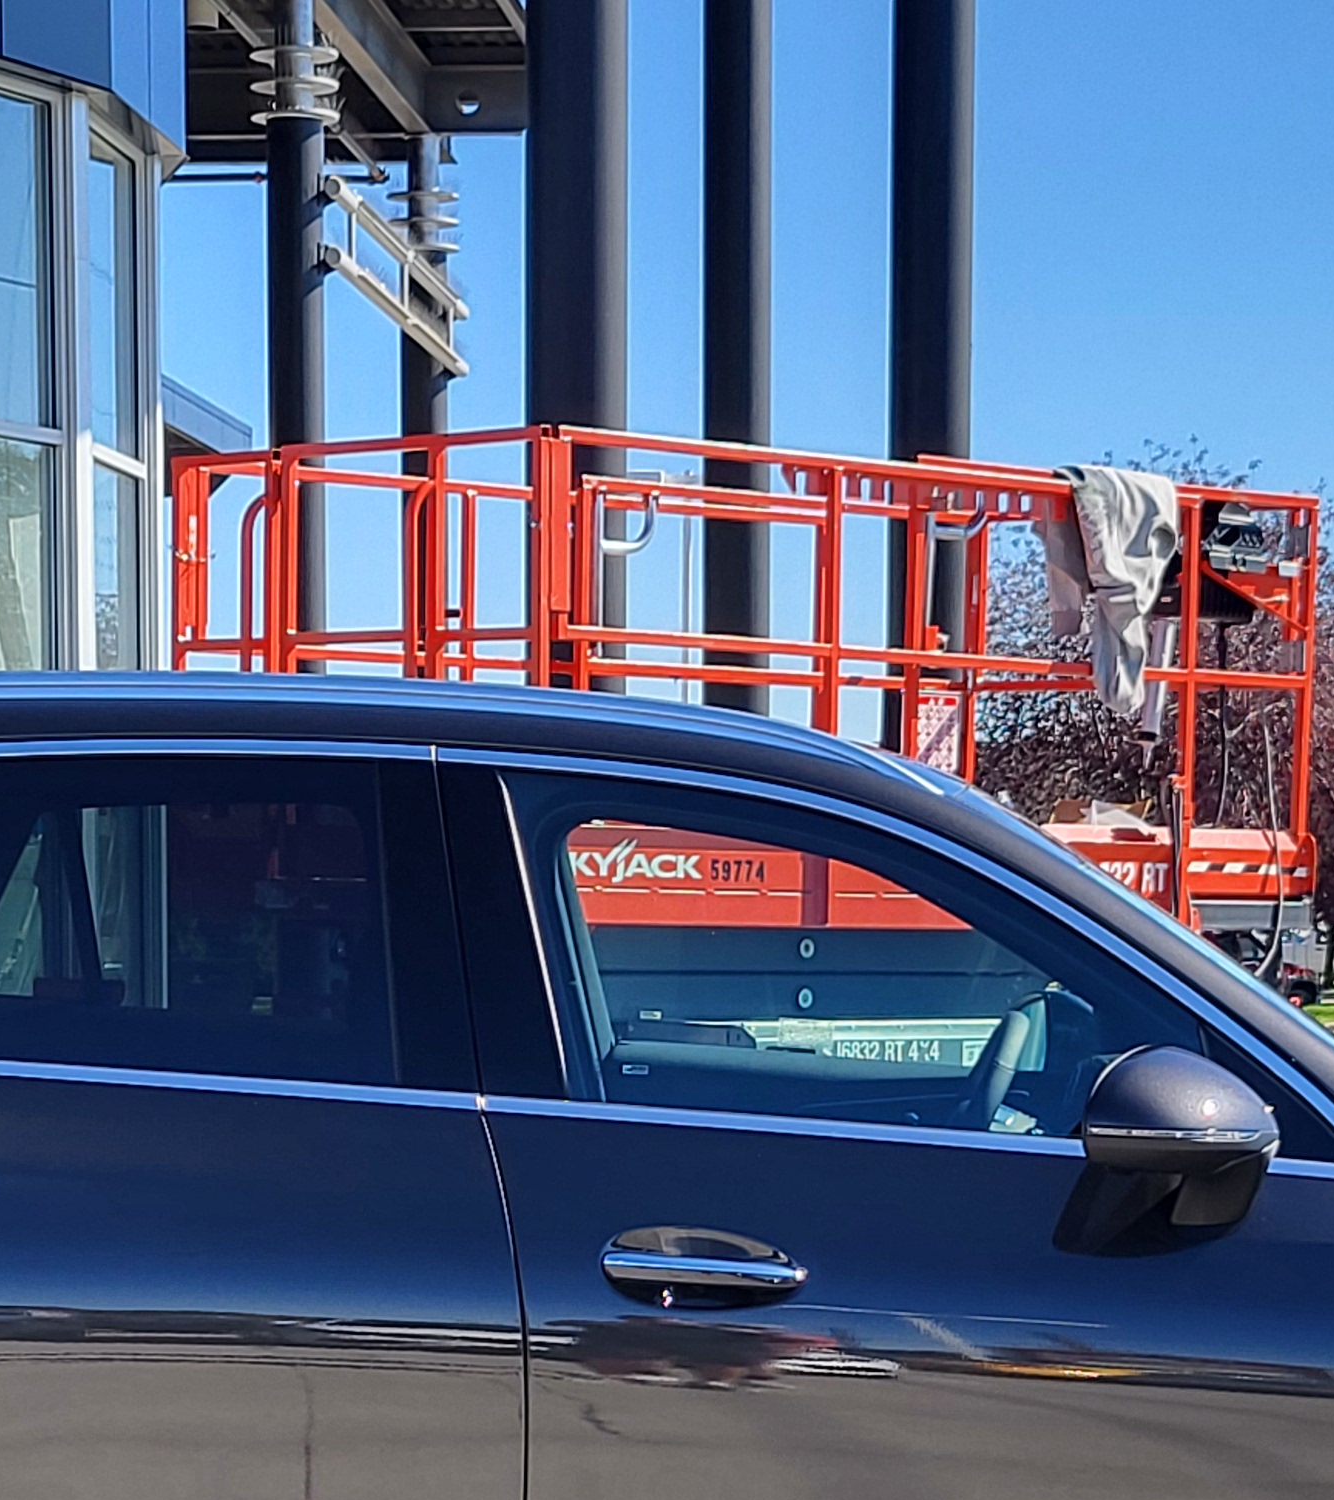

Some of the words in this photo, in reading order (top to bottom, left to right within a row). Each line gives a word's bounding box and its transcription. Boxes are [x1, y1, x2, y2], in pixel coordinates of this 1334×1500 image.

[710, 859, 765, 882] 59774
[1141, 861, 1168, 897] RT
[884, 1041, 906, 1062] RT
